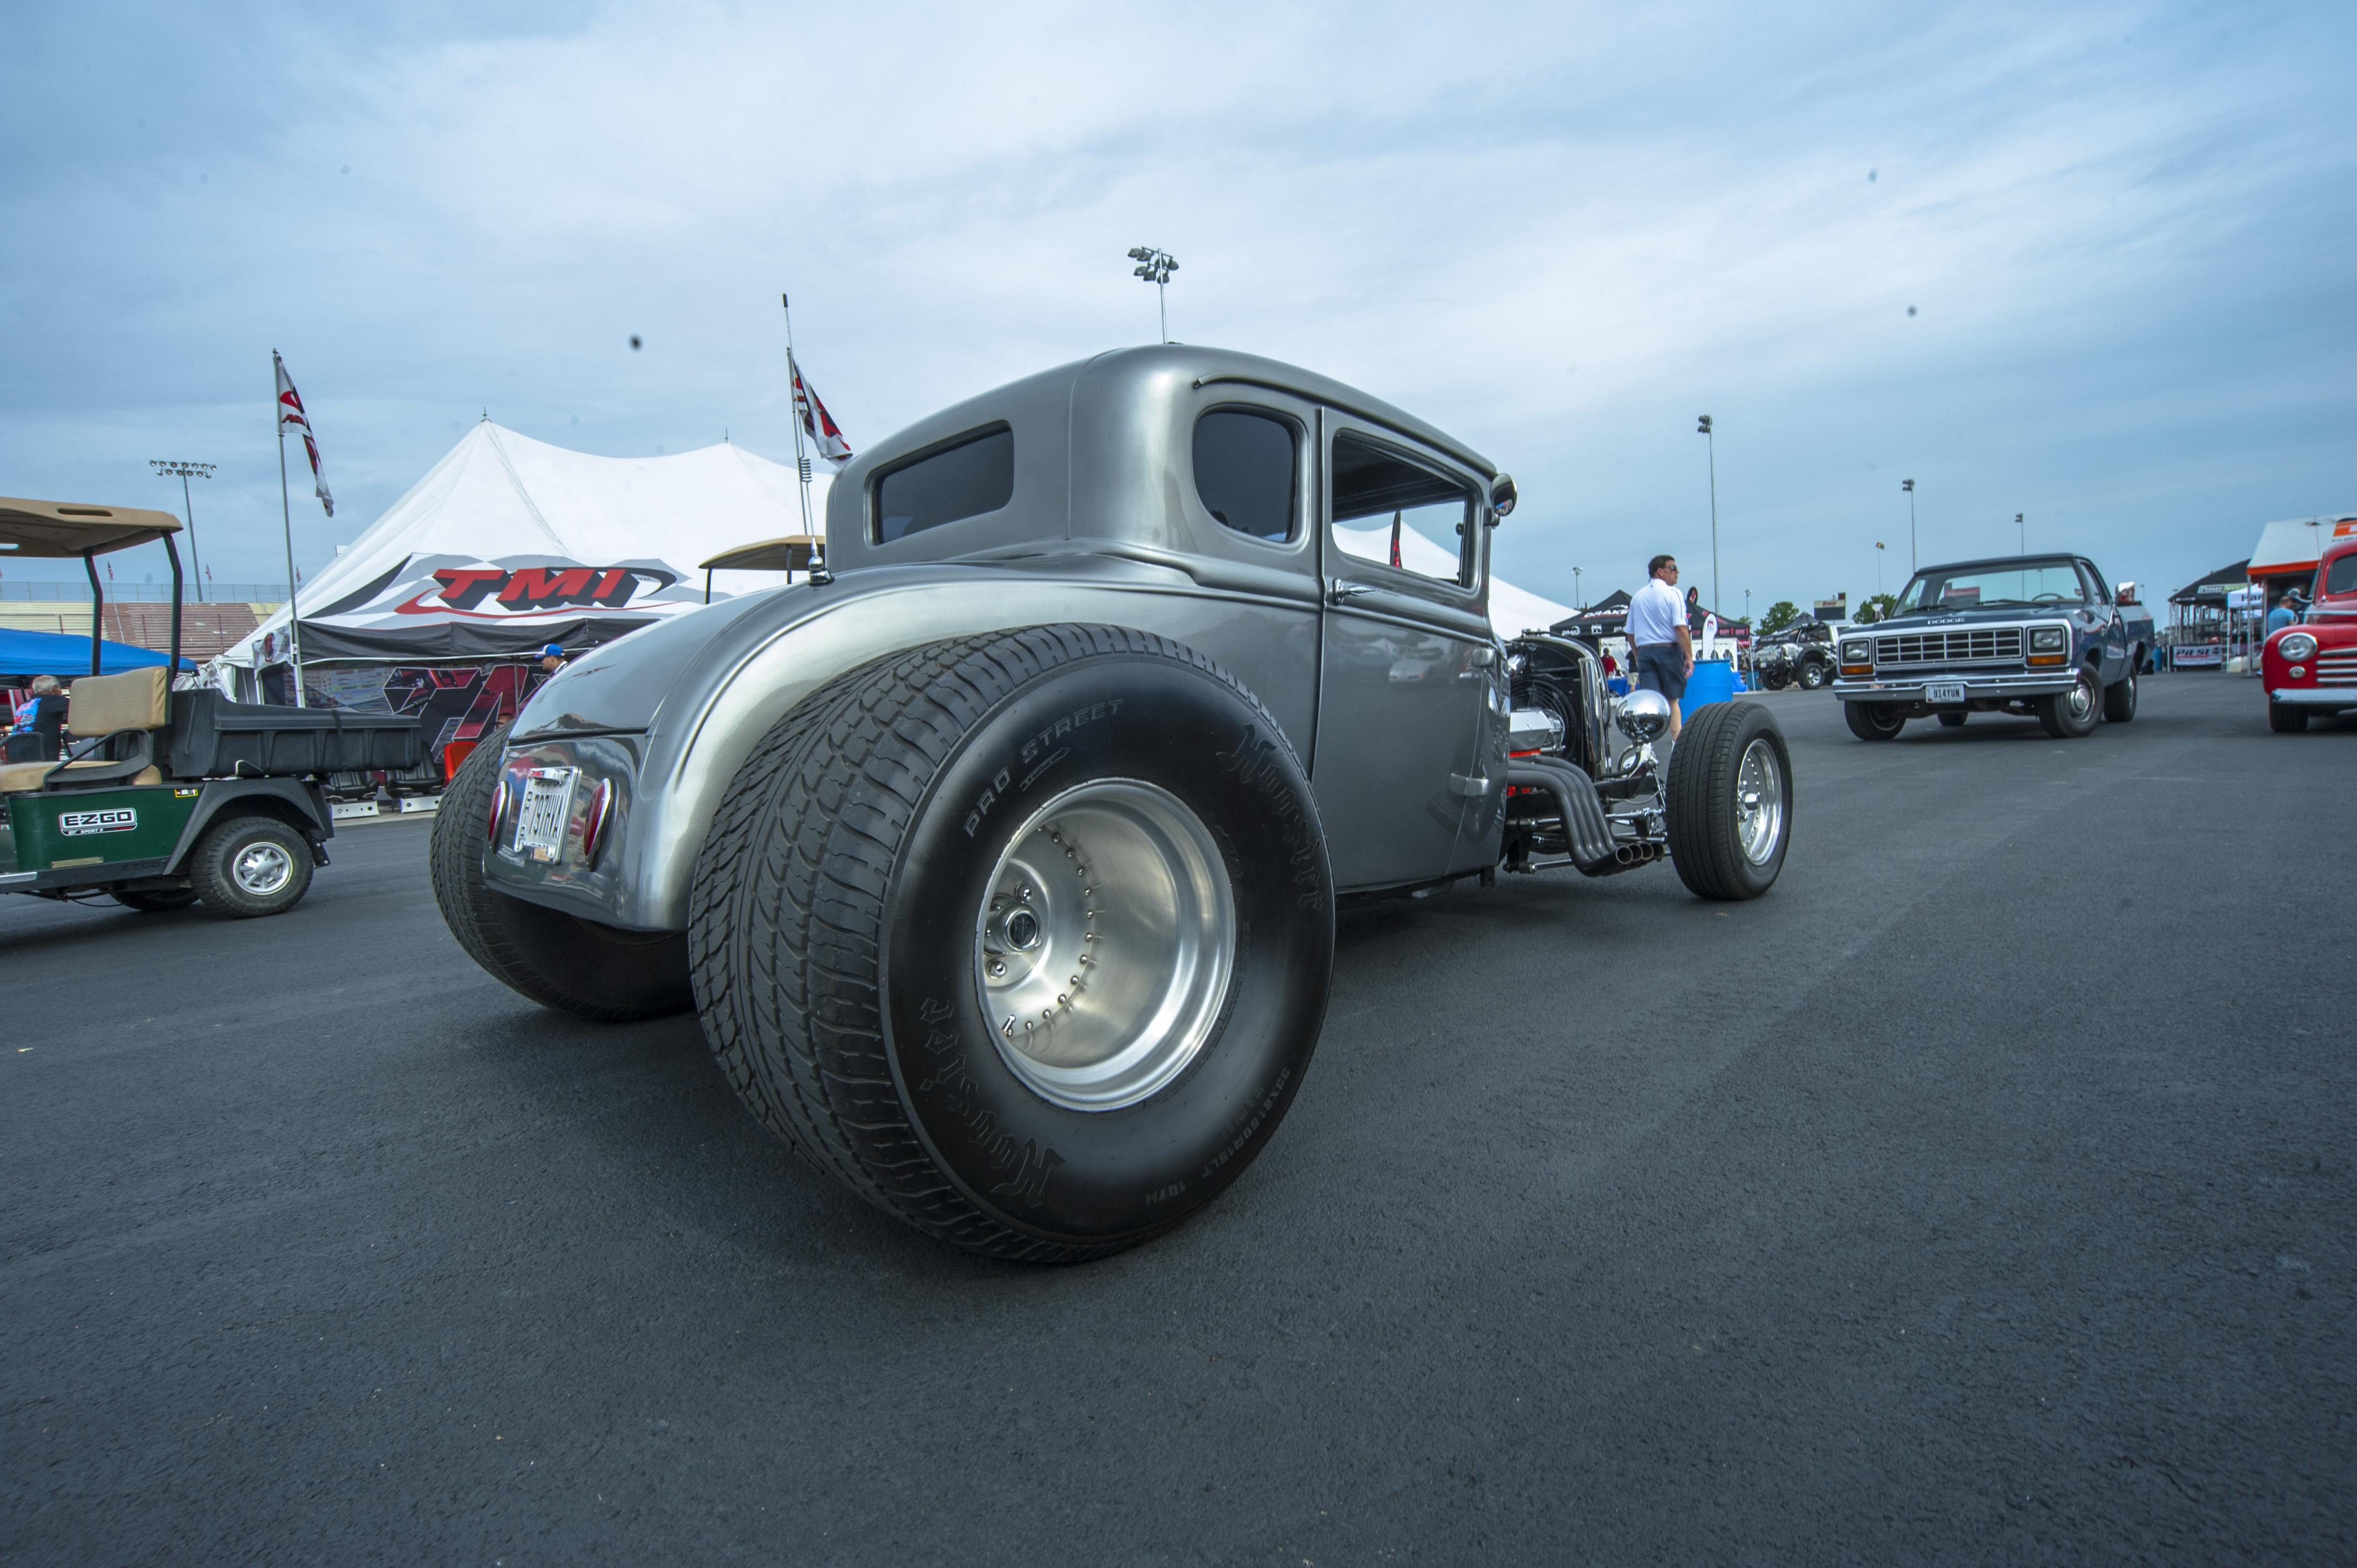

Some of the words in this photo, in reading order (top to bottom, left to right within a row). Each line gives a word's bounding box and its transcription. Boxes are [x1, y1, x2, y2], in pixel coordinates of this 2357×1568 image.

[432, 567, 635, 610] TMI
[1933, 688, 1959, 698] 914YUN
[964, 767, 1010, 838] PRO
[1020, 699, 1124, 764] STREET
[529, 793, 564, 838] 797HVA
